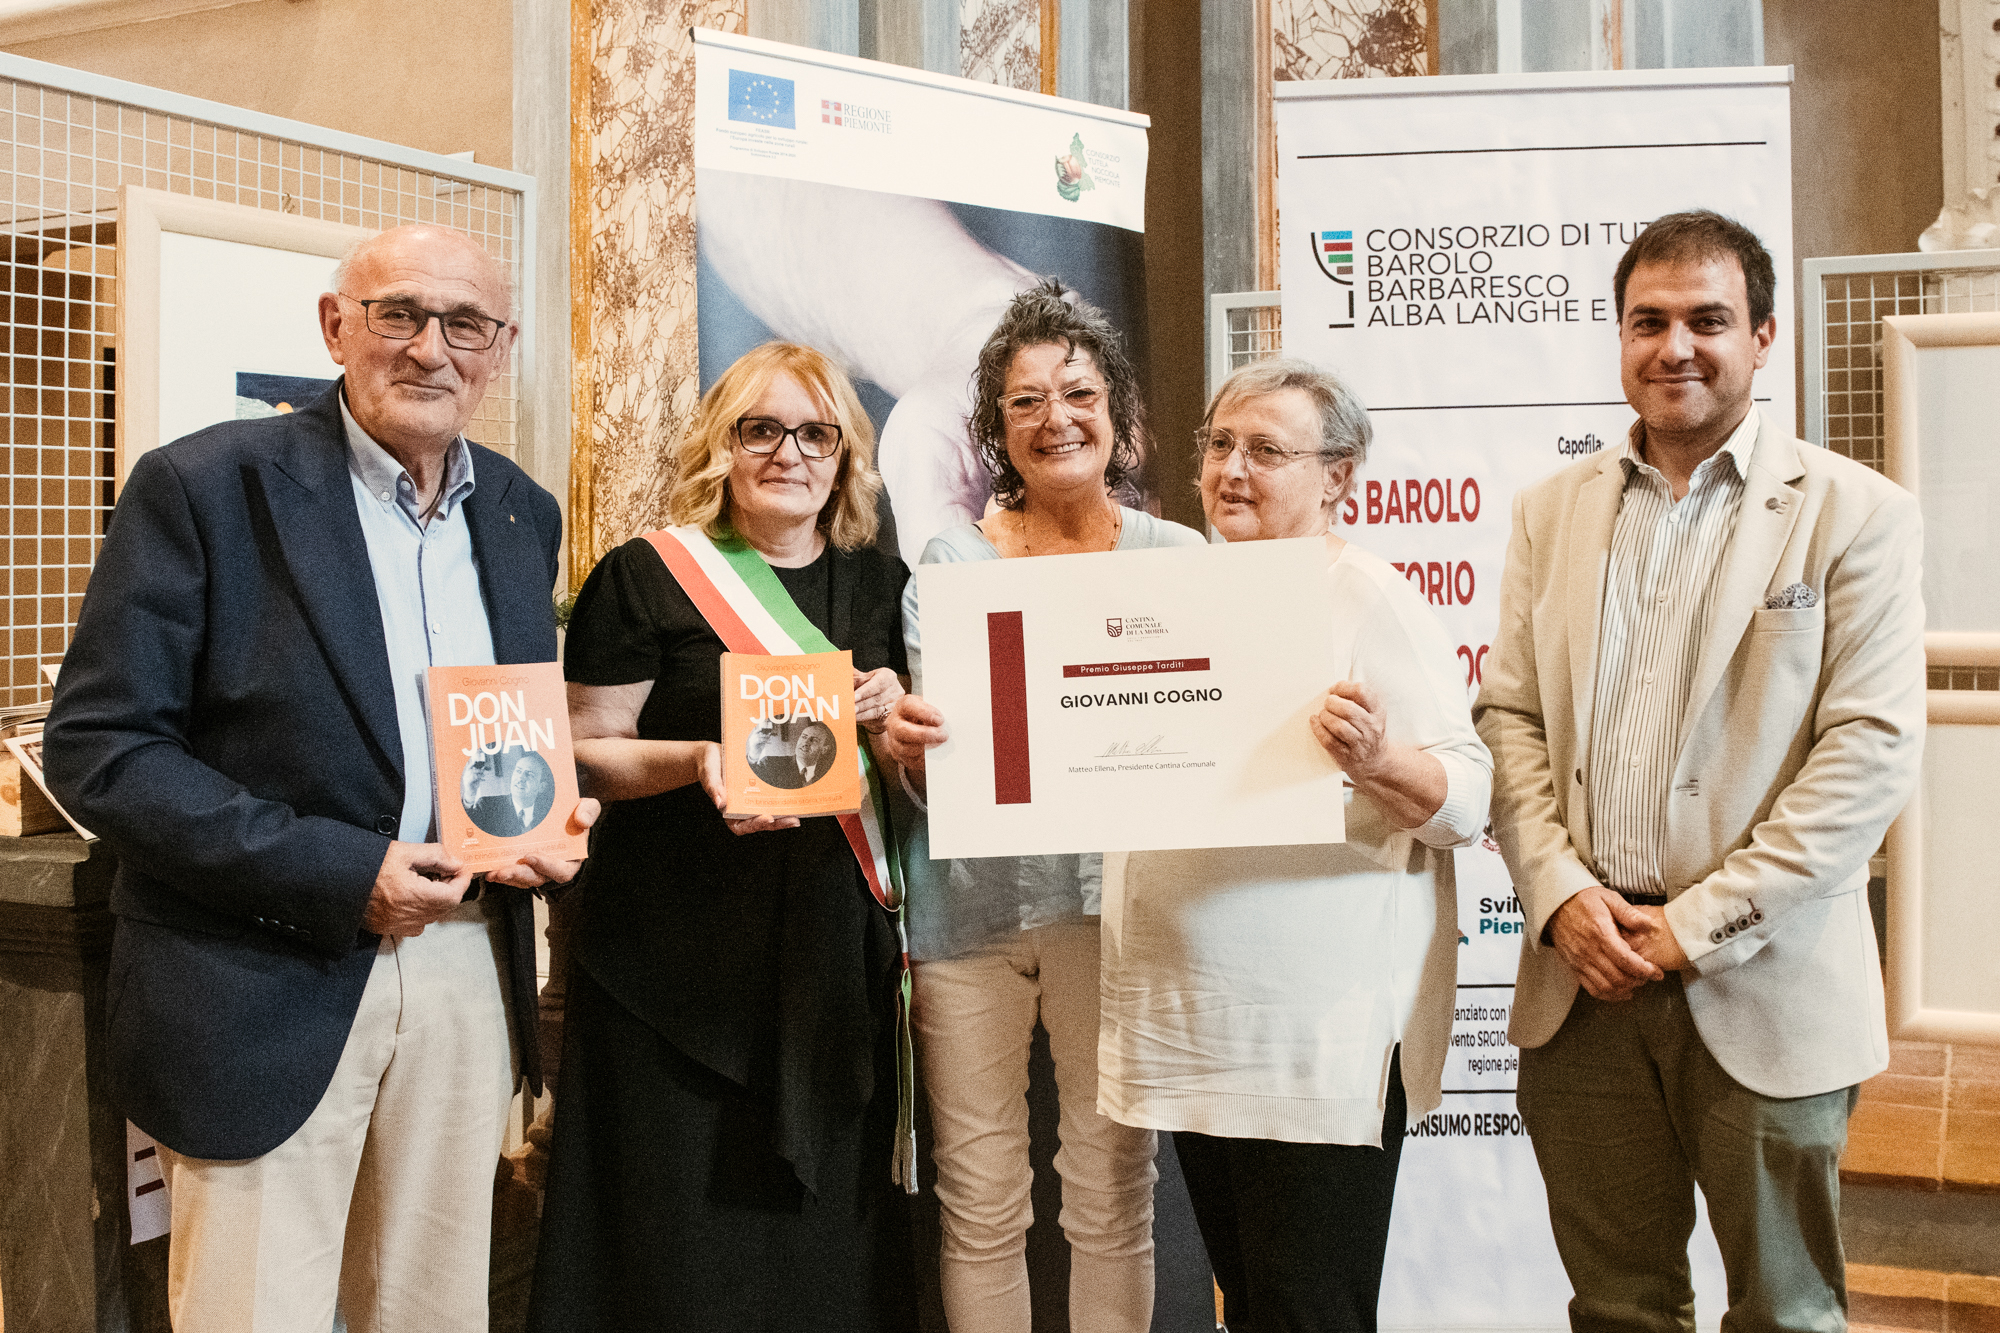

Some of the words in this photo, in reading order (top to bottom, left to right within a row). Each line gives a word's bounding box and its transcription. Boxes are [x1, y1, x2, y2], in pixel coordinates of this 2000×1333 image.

[843, 103, 892, 123] REGIONE
[843, 116, 893, 135] PIEMONTE
[1085, 149, 1121, 162] CONSORZIO
[1087, 157, 1109, 168] TUTELA
[1091, 166, 1120, 180] NOCCIOLA
[1094, 175, 1121, 188] PIEMONTE
[1366, 223, 1550, 252] CONSORZIO
[1560, 223, 1590, 247] DI
[1367, 250, 1493, 278] BAROLO
[1367, 274, 1569, 303] BARBARESCO
[1367, 302, 1446, 328] ALBA
[1456, 299, 1580, 325] LANGHE
[1591, 298, 1607, 322] E
[1365, 477, 1481, 525] BAROLO
[1125, 622, 1162, 630] COMUNALE
[754, 663, 790, 672] Giovanni
[791, 662, 821, 673] Cogno
[1080, 665, 1110, 674] Premio
[1112, 663, 1154, 672] Giuseppe
[1155, 660, 1185, 670] Tarditi
[461, 677, 498, 687] Giovanni
[499, 675, 530, 687] Cogno
[740, 673, 815, 700] DON
[1060, 691, 1149, 709] GIOVANNI
[1153, 687, 1223, 705] COGNO
[447, 690, 526, 727] DON
[749, 694, 840, 725] JUAN
[461, 717, 556, 757] JUAN
[1094, 764, 1117, 773] Ellena,
[1117, 763, 1154, 771] Presidente
[1181, 760, 1216, 768] Comunale
[1489, 1007, 1507, 1021] con
[1477, 1030, 1506, 1047] SRG10
[1406, 1113, 1472, 1137] NSUMO
